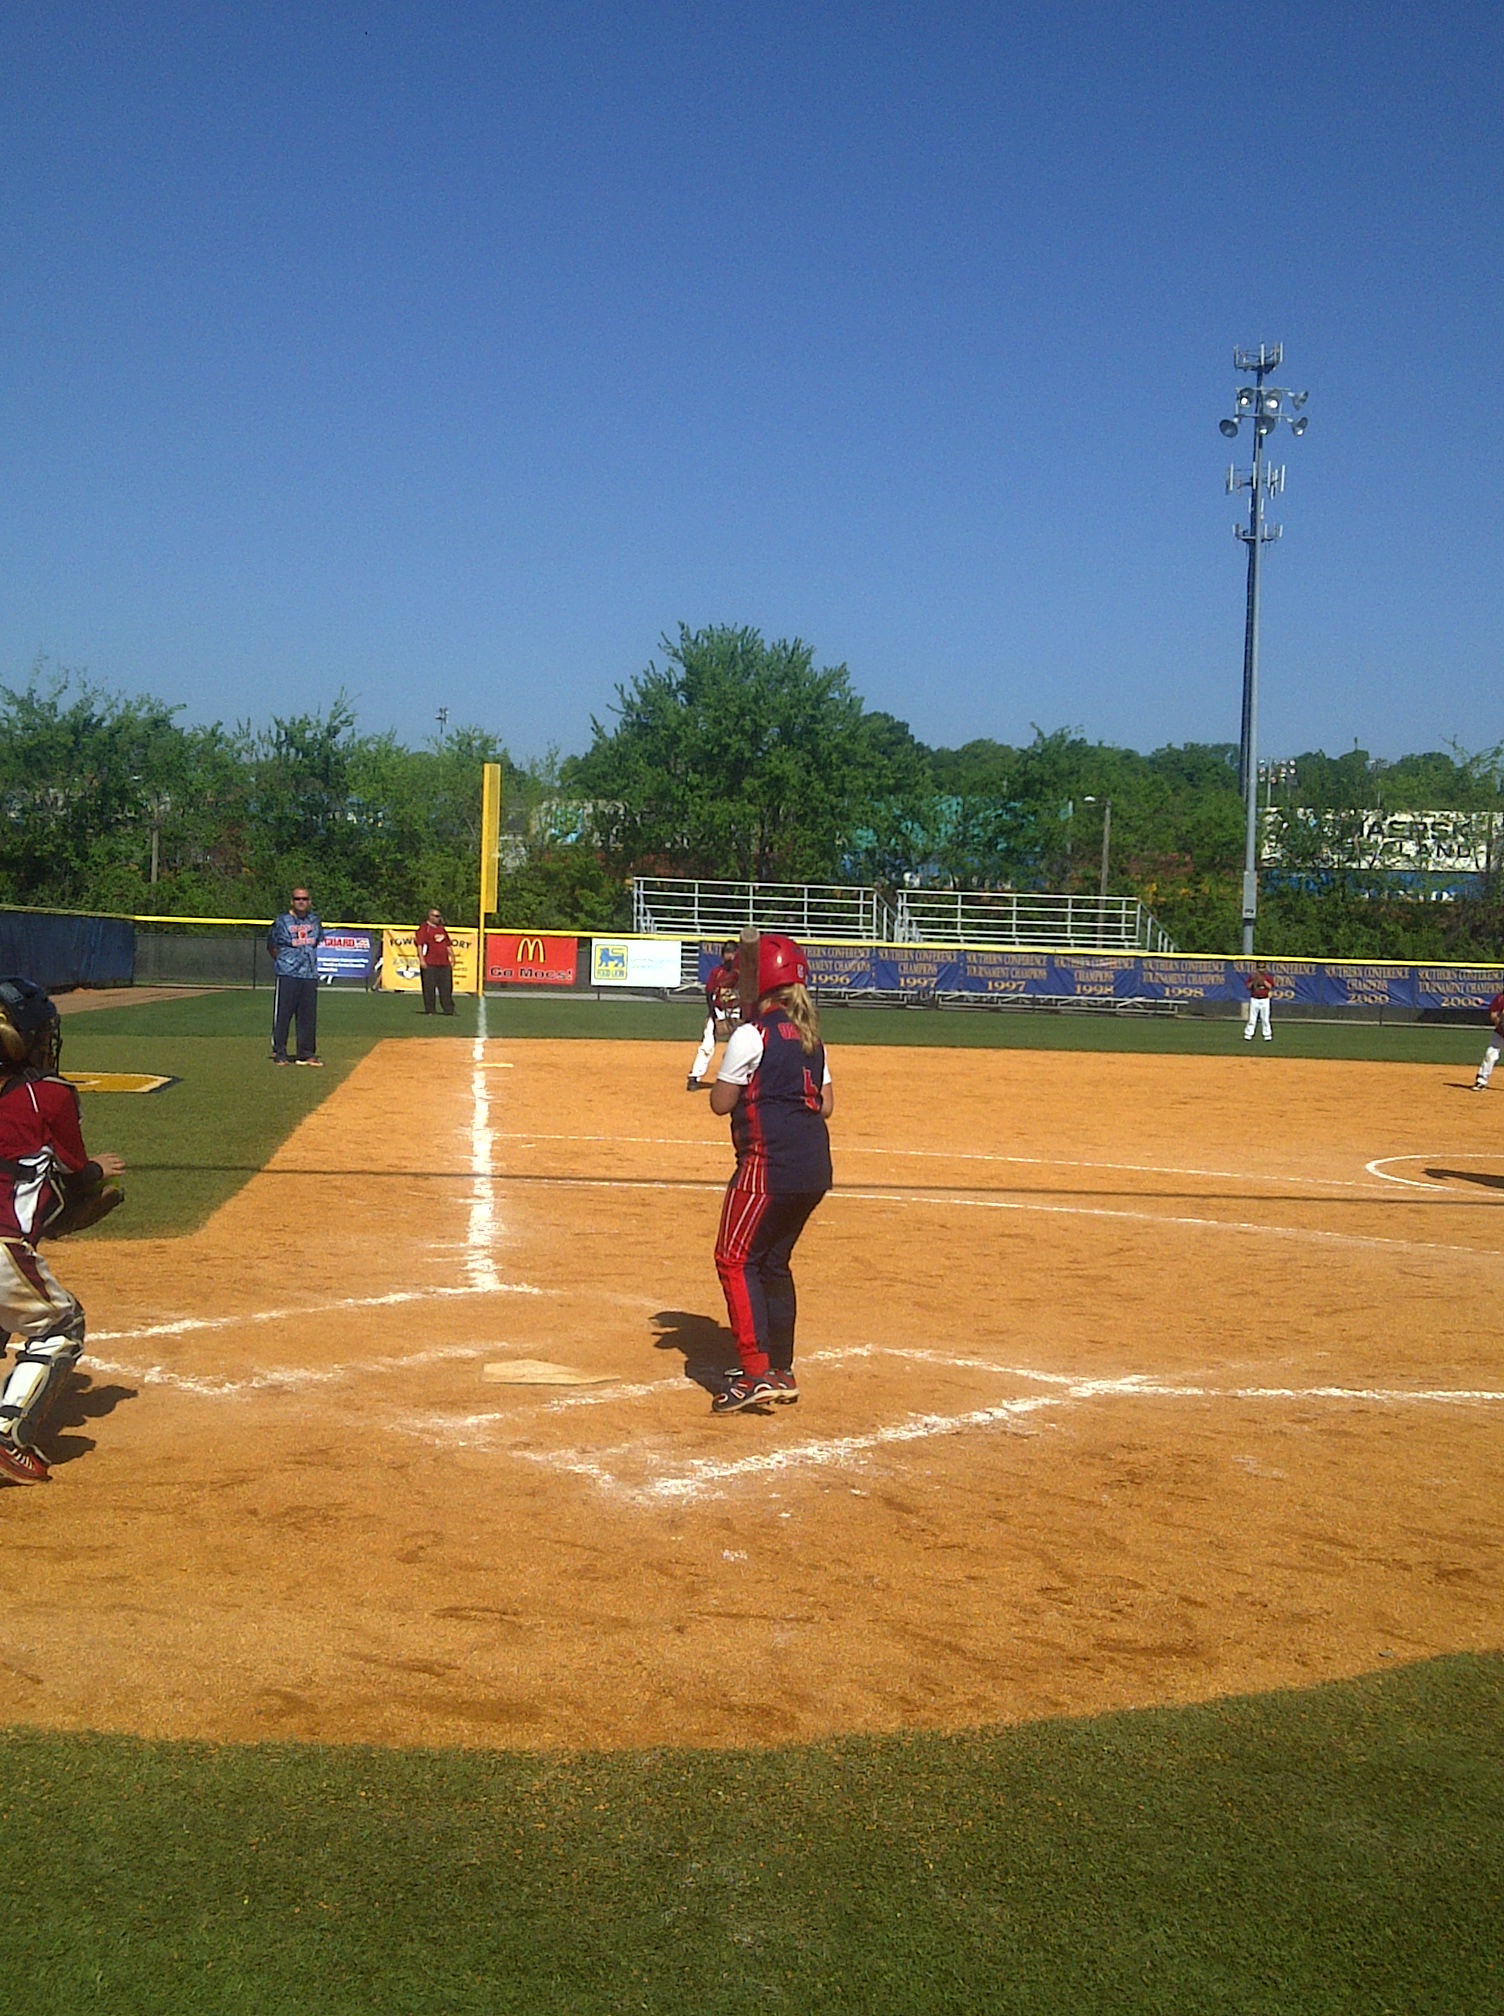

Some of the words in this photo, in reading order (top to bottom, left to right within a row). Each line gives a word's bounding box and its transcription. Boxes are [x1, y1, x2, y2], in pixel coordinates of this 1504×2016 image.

[828, 947, 870, 959] CONFERENCE
[879, 949, 914, 960] SOUTHERN
[915, 950, 957, 962] CONFERENCE
[966, 952, 1001, 965] SOUTHERN
[1004, 953, 1048, 967] CONFERENCE
[834, 960, 871, 972] CHAMPIONS
[898, 962, 938, 975] CHAMPIONS
[1054, 955, 1090, 968] SOUTHERN
[1092, 956, 1135, 970] CONFERENCE
[1142, 959, 1178, 972] SOUTHERN
[1181, 959, 1226, 972] CONFERENCE
[1272, 962, 1317, 975] CONFERENCE
[490, 966, 513, 977] Go
[966, 965, 1009, 978] TOURNAMENT
[1011, 967, 1048, 980] CHAMPIONS
[1074, 969, 1115, 983] CHAMPIONS
[1142, 971, 1186, 985] TOURNAMENT
[1188, 972, 1226, 985] CHAMPIONS
[1325, 965, 1362, 978] SOUTHERN
[1364, 966, 1410, 979] CONFERENCE
[1418, 968, 1457, 981] SOUTHERN
[811, 974, 851, 985] 1996
[900, 977, 938, 988] 1997
[987, 980, 1026, 992] 1997
[1346, 978, 1389, 992] CHAMPIONS
[1075, 984, 1115, 995] 1998
[1164, 987, 1205, 998] 1998
[1419, 980, 1464, 993] TOURNAMENT
[1347, 993, 1390, 1005] 2000
[1441, 996, 1485, 1008] 2000
